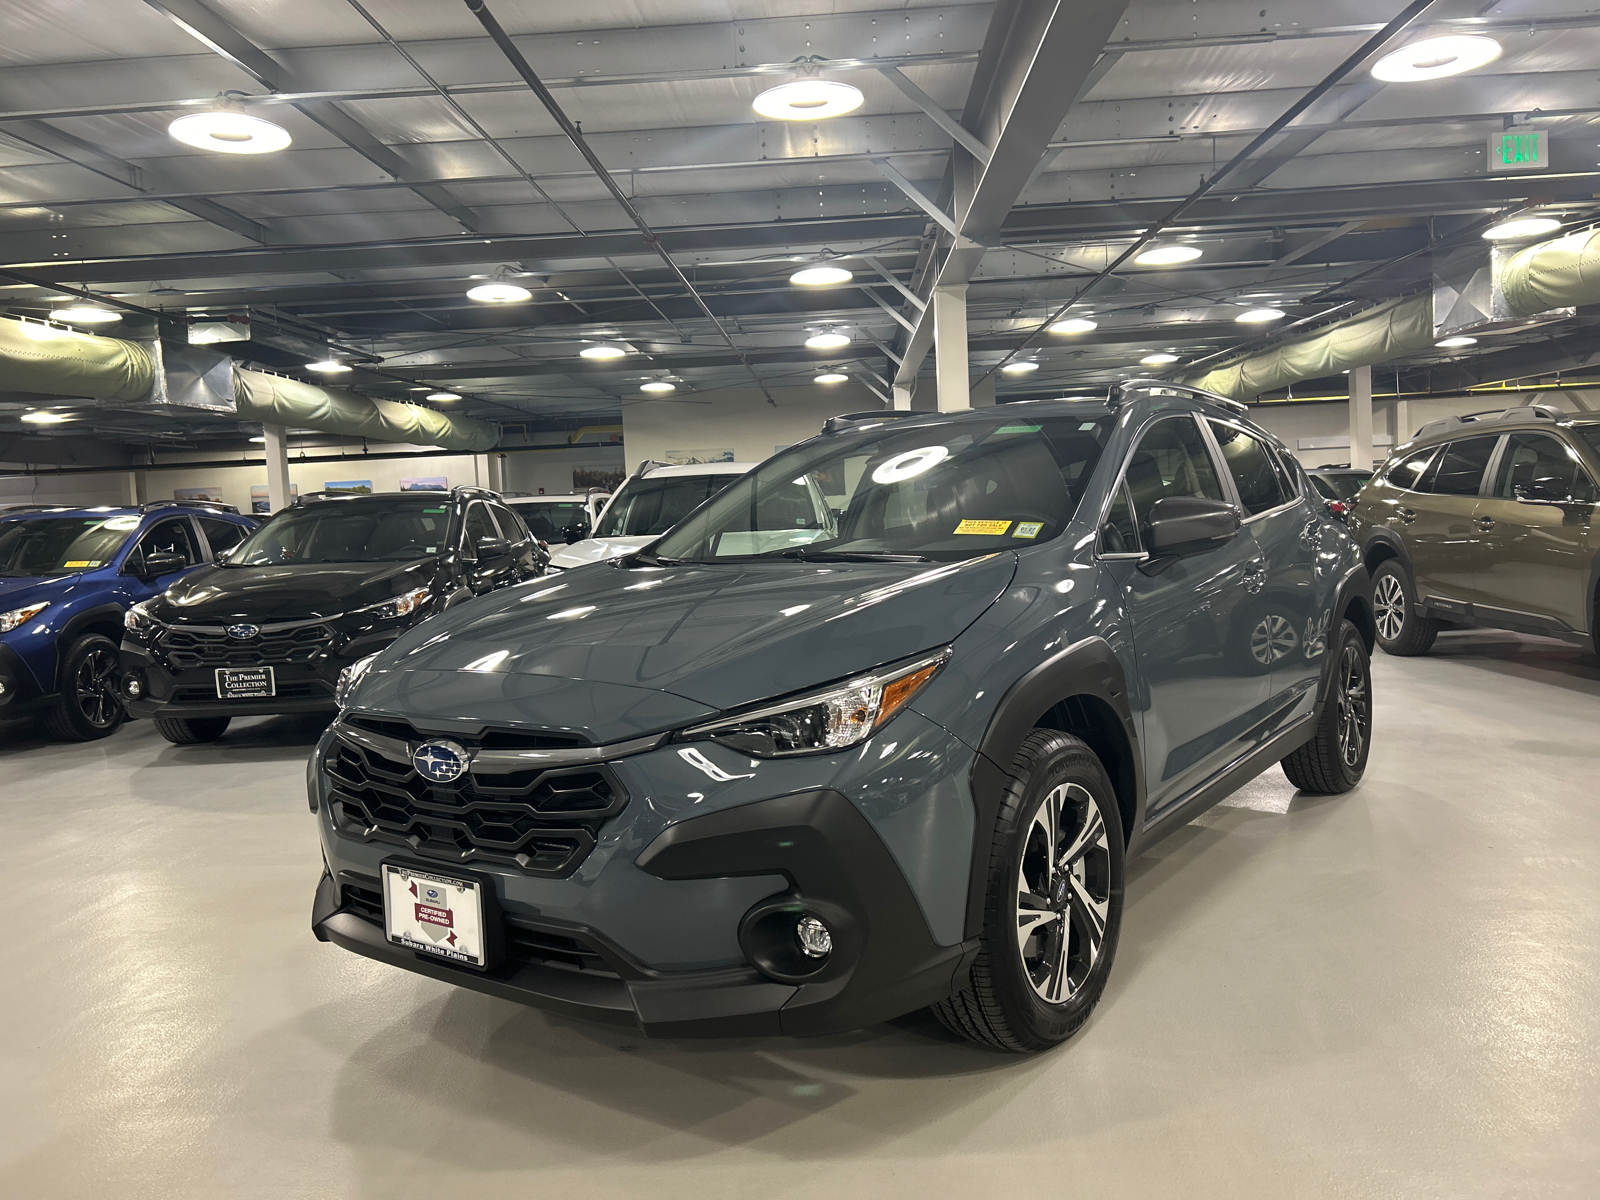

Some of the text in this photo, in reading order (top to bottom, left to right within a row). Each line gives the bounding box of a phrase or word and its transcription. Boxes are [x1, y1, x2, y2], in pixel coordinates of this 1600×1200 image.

[1502, 134, 1539, 164] EXIT
[224, 673, 267, 682] THE PREMIER
[224, 681, 267, 689] COLLECTION
[420, 906, 447, 918] CERTIFIED
[418, 912, 450, 925] PRE-OWNED
[400, 938, 468, 961] Subaru White Plains
